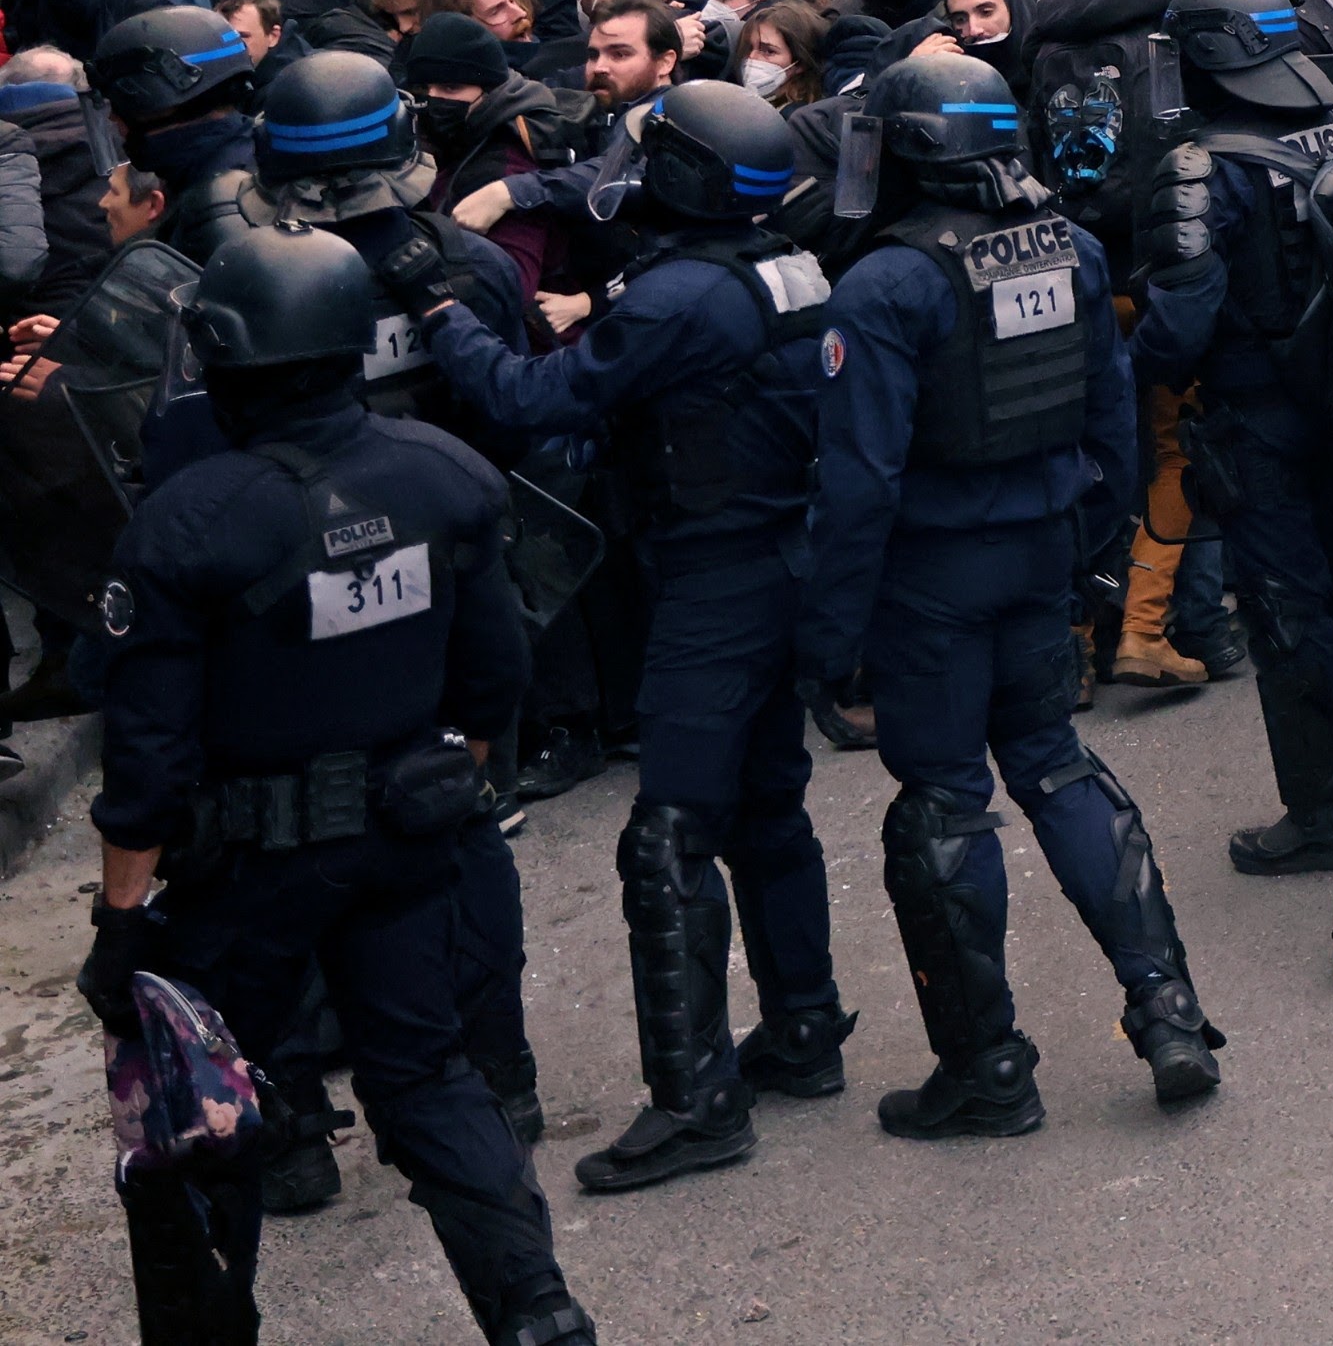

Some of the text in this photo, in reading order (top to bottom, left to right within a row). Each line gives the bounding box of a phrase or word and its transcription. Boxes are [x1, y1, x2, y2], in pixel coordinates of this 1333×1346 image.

[970, 220, 1073, 270] POLICE
[1015, 286, 1057, 319] 121
[388, 327, 422, 358] 12
[328, 517, 388, 547] POLICE
[346, 568, 403, 614] 311
